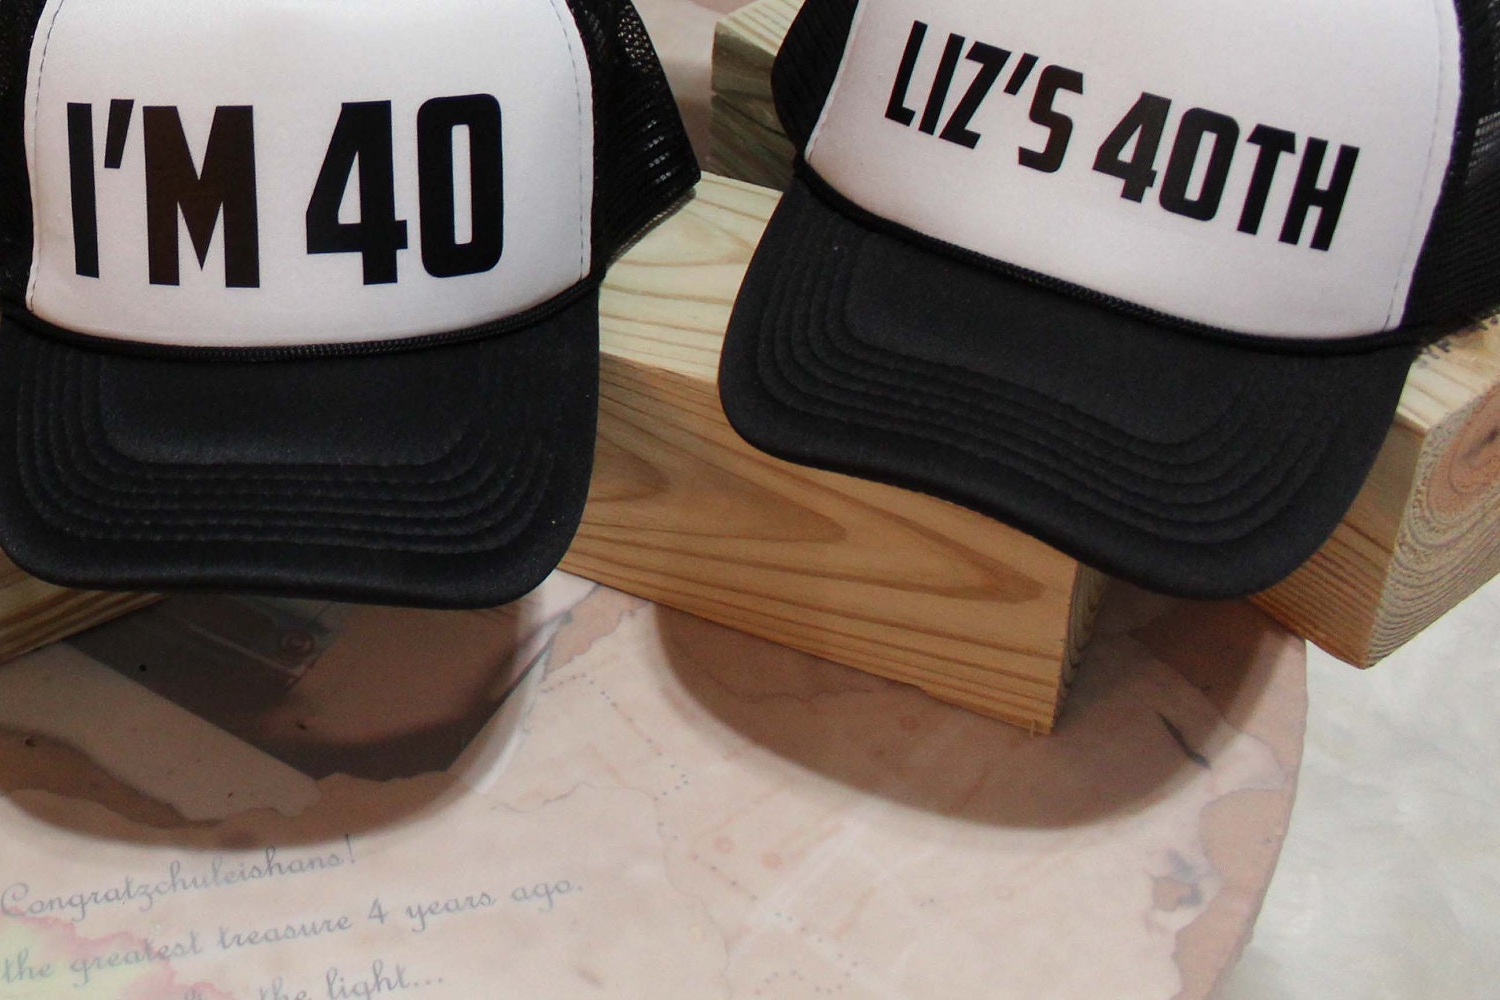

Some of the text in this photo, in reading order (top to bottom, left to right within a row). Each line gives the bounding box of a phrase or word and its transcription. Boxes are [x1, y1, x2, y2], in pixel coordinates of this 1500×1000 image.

[66, 93, 505, 289] I'M 40
[884, 20, 1360, 252] LIZ'S 40TH
[1, 950, 54, 985] the
[70, 929, 202, 975] greatest
[217, 914, 352, 951] treasure
[368, 897, 388, 925] 4
[405, 890, 498, 934] years
[510, 876, 585, 912] ago.
